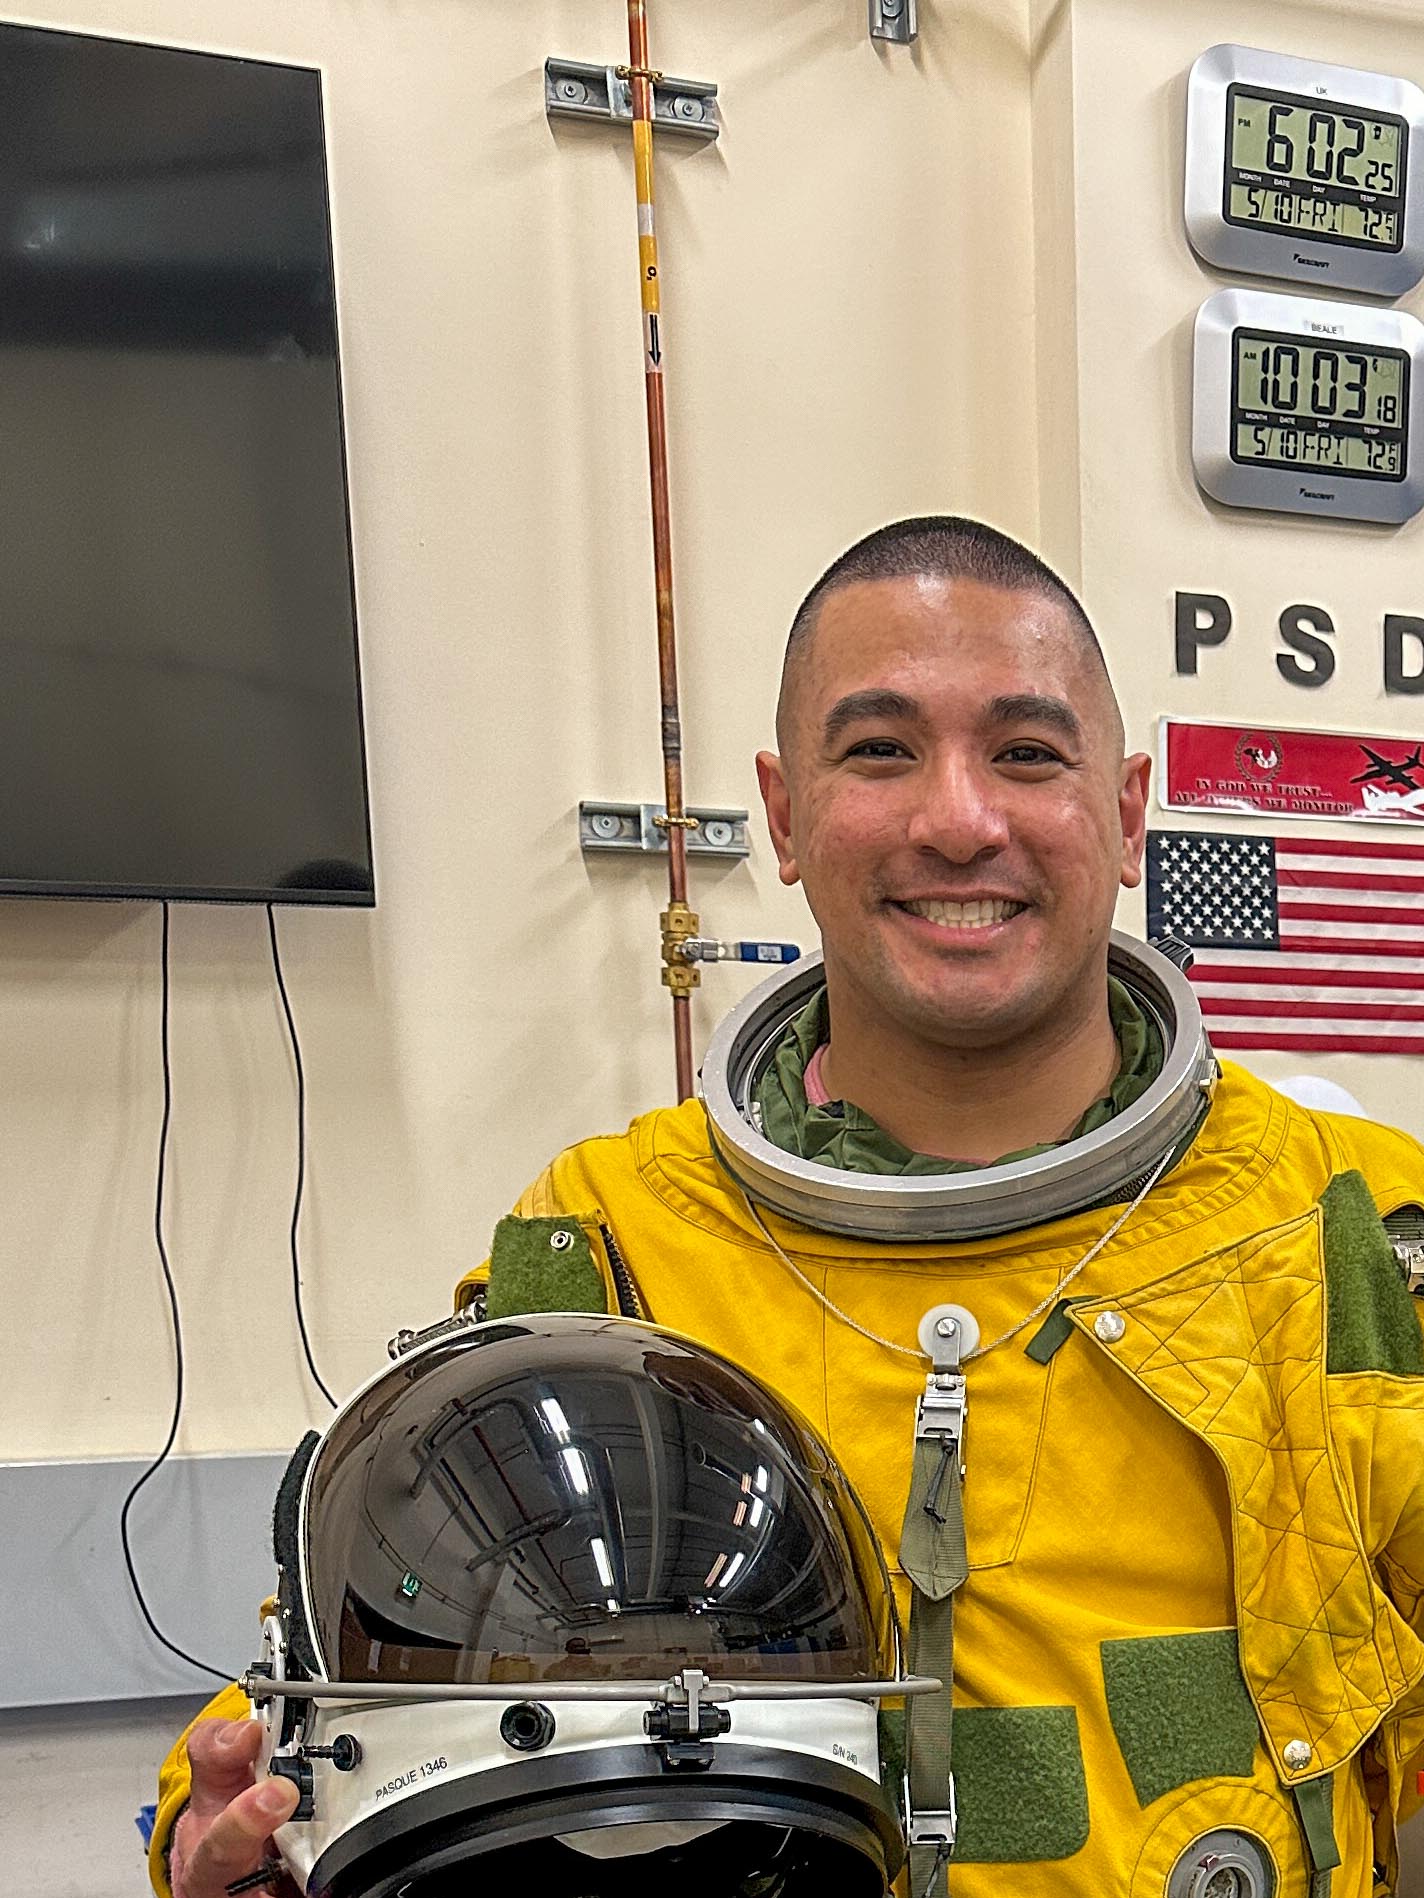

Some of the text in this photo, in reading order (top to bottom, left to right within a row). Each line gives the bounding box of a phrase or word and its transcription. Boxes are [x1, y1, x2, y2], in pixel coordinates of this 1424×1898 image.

[1316, 86, 1328, 95] UK
[1238, 118, 1251, 128] PM
[1239, 172, 1262, 183] MONTH
[1274, 178, 1291, 188] DATE
[1312, 185, 1325, 193] DAY
[1297, 196, 1341, 233] FRI
[1311, 323, 1337, 335] BEALE
[1244, 351, 1257, 361] AM
[1245, 412, 1380, 436] MONTH DATE DAY TEMP
[1303, 432, 1344, 466] FRI
[1195, 778, 1211, 790] IN
[1216, 780, 1247, 792] GOD
[1250, 782, 1273, 794] WE
[1175, 791, 1199, 803] ALL
[1266, 798, 1287, 809] WE
[1292, 800, 1354, 813] MONITOR
[375, 1757, 448, 1801] PASQUE 1346
